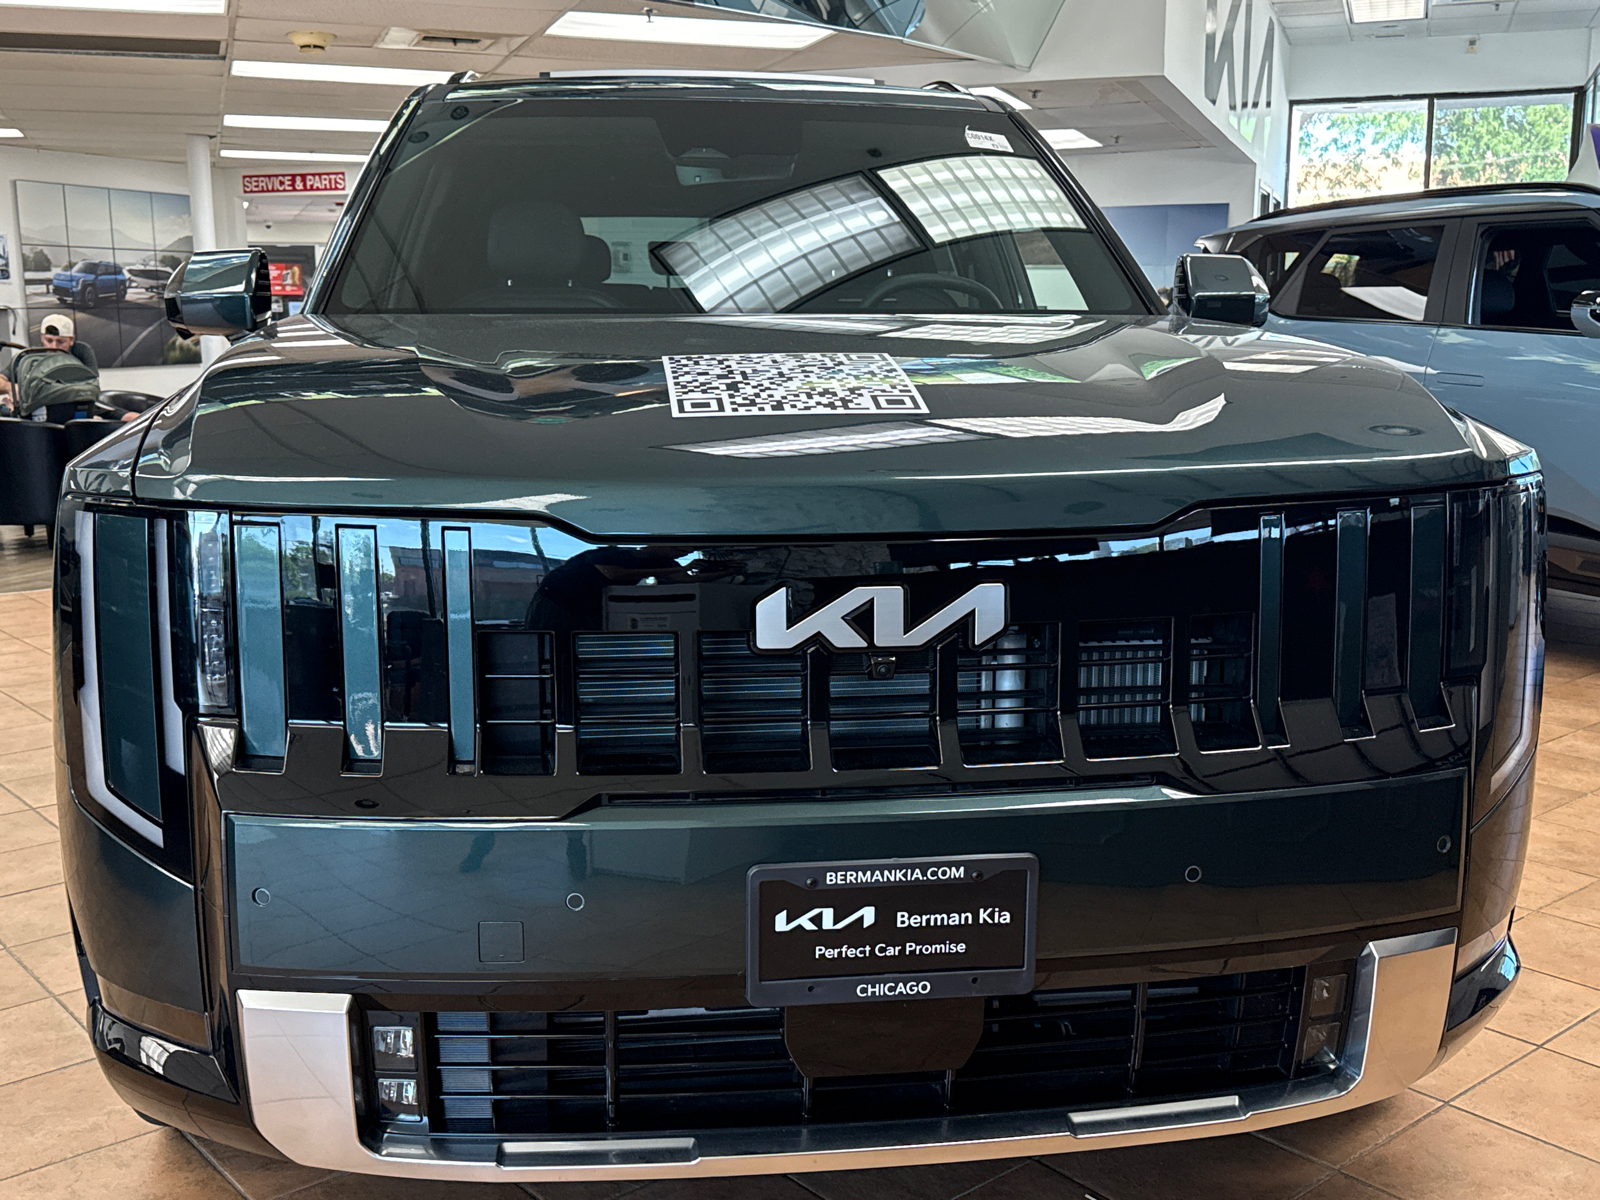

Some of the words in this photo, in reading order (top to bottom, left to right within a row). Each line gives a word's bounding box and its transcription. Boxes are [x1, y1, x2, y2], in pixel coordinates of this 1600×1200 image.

[243, 176, 293, 192] SERVICE
[295, 175, 304, 190] &
[306, 174, 344, 190] PARTS
[826, 866, 965, 885] BERMANKIA.COM
[896, 911, 973, 928] Berman
[979, 907, 1011, 925] Kia
[815, 944, 872, 959] Perfect
[874, 943, 902, 957] Car
[905, 940, 966, 955] Promise
[856, 980, 931, 997] CHICAGO
